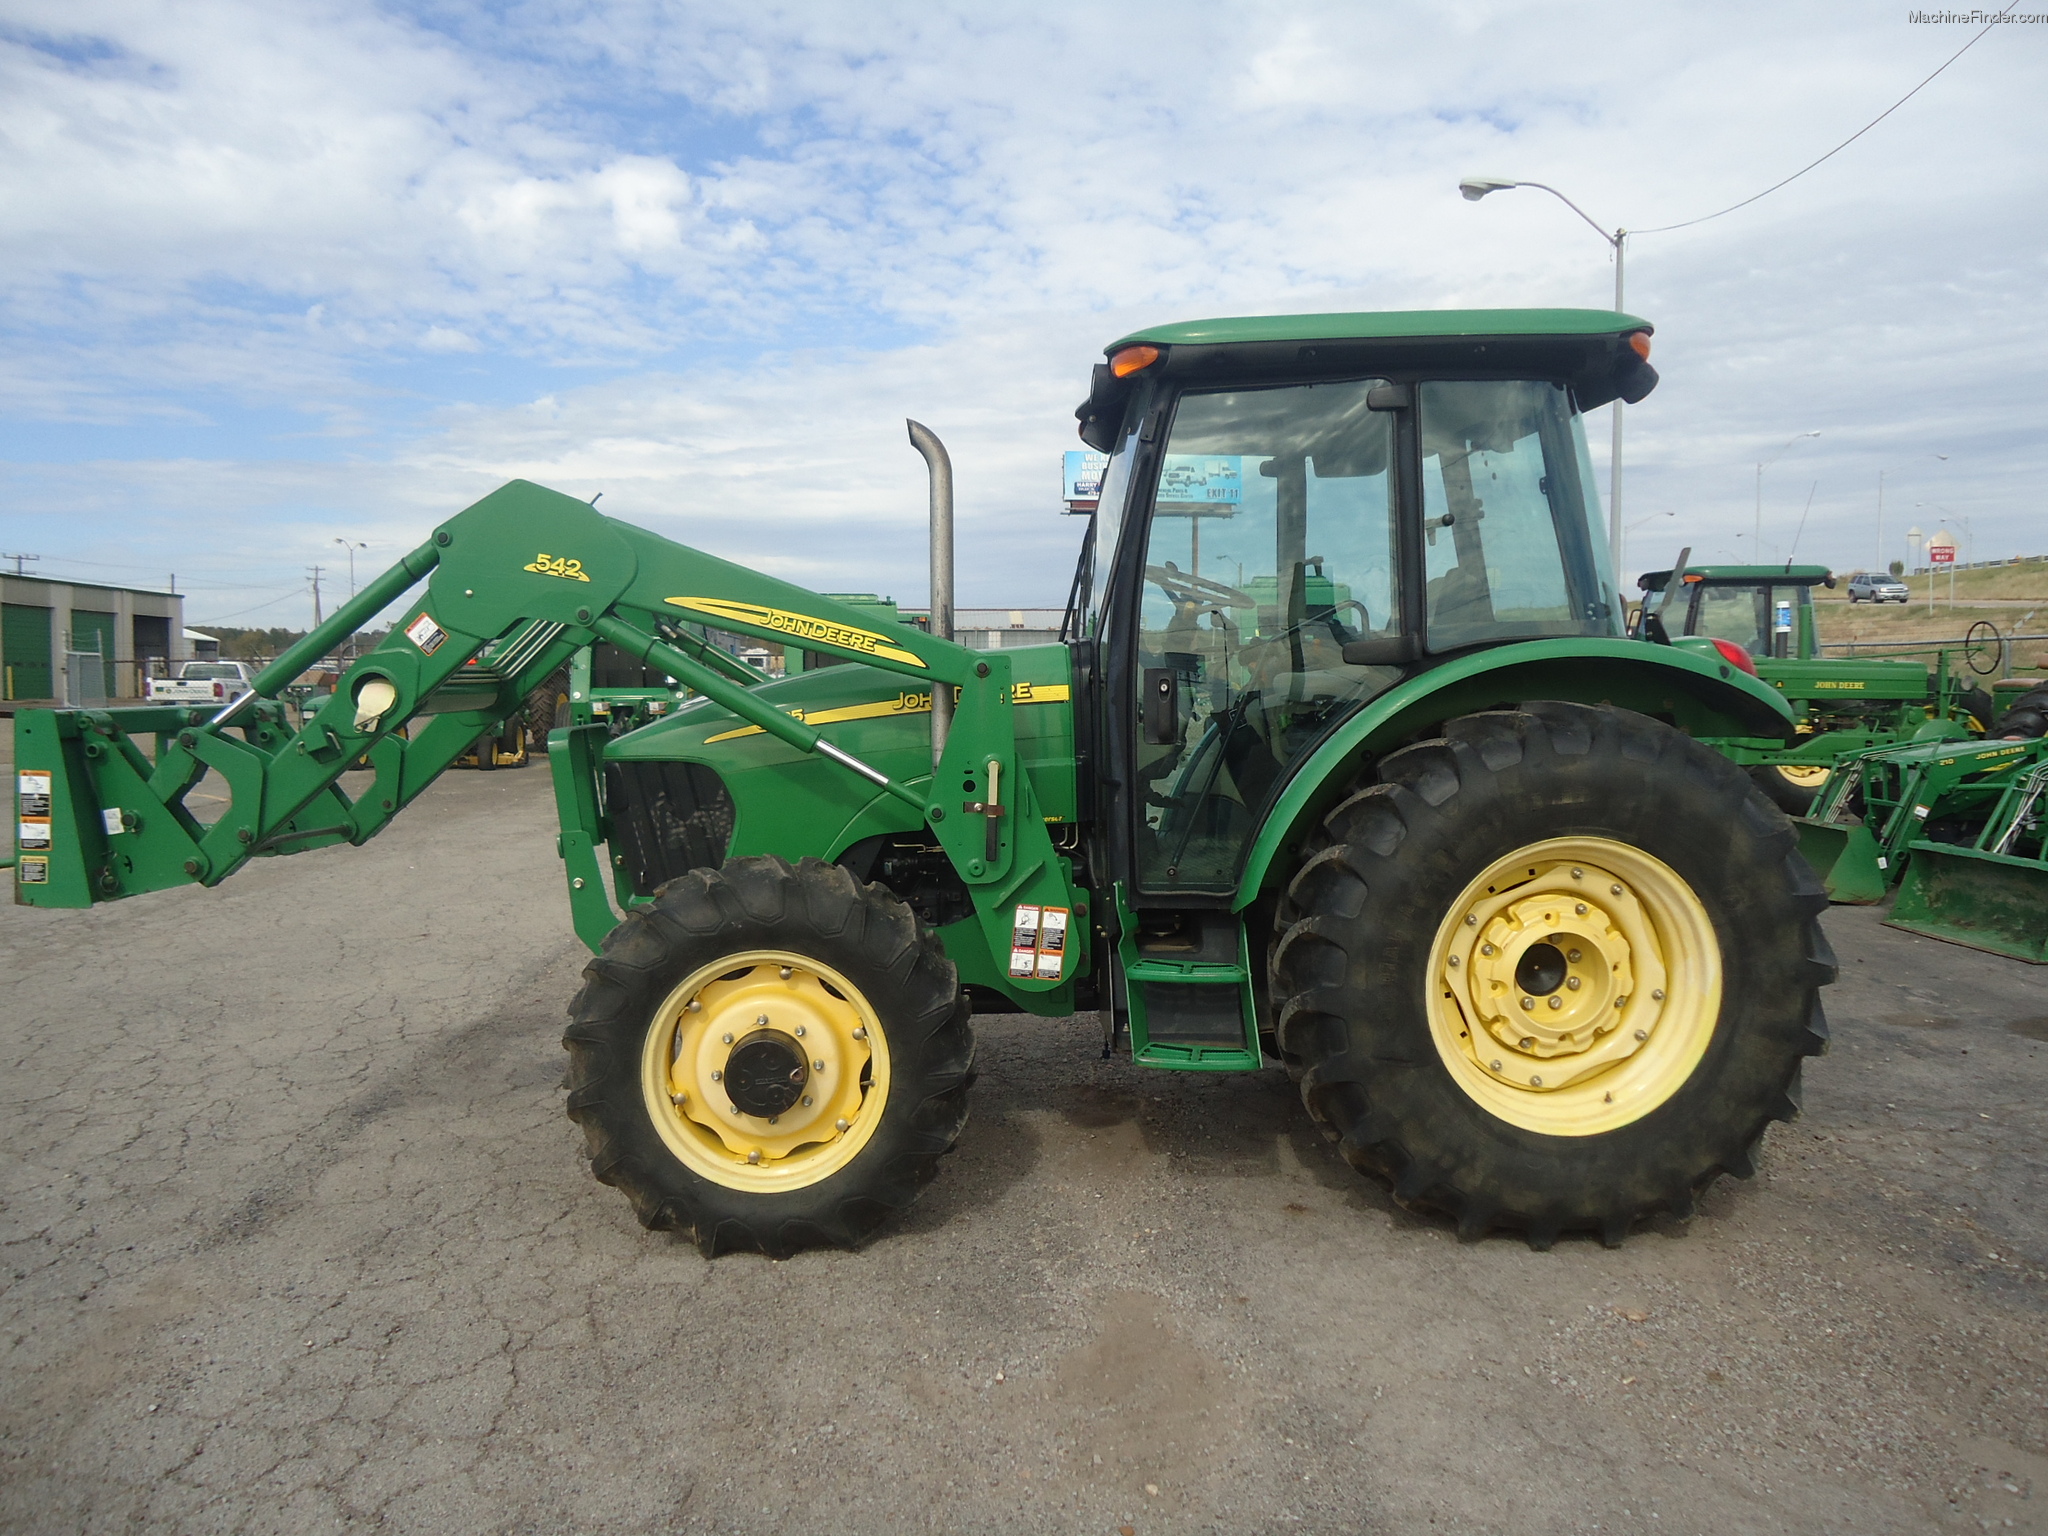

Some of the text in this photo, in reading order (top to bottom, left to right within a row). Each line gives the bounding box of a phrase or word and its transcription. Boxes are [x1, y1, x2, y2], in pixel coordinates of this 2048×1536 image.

[1081, 462, 1108, 470] BUSIN
[1207, 488, 1239, 498] EXIT 11
[536, 553, 581, 579] 542
[1814, 681, 1865, 690] JOHN DEERE
[1939, 746, 2026, 766] 210 JOHN DEERE
